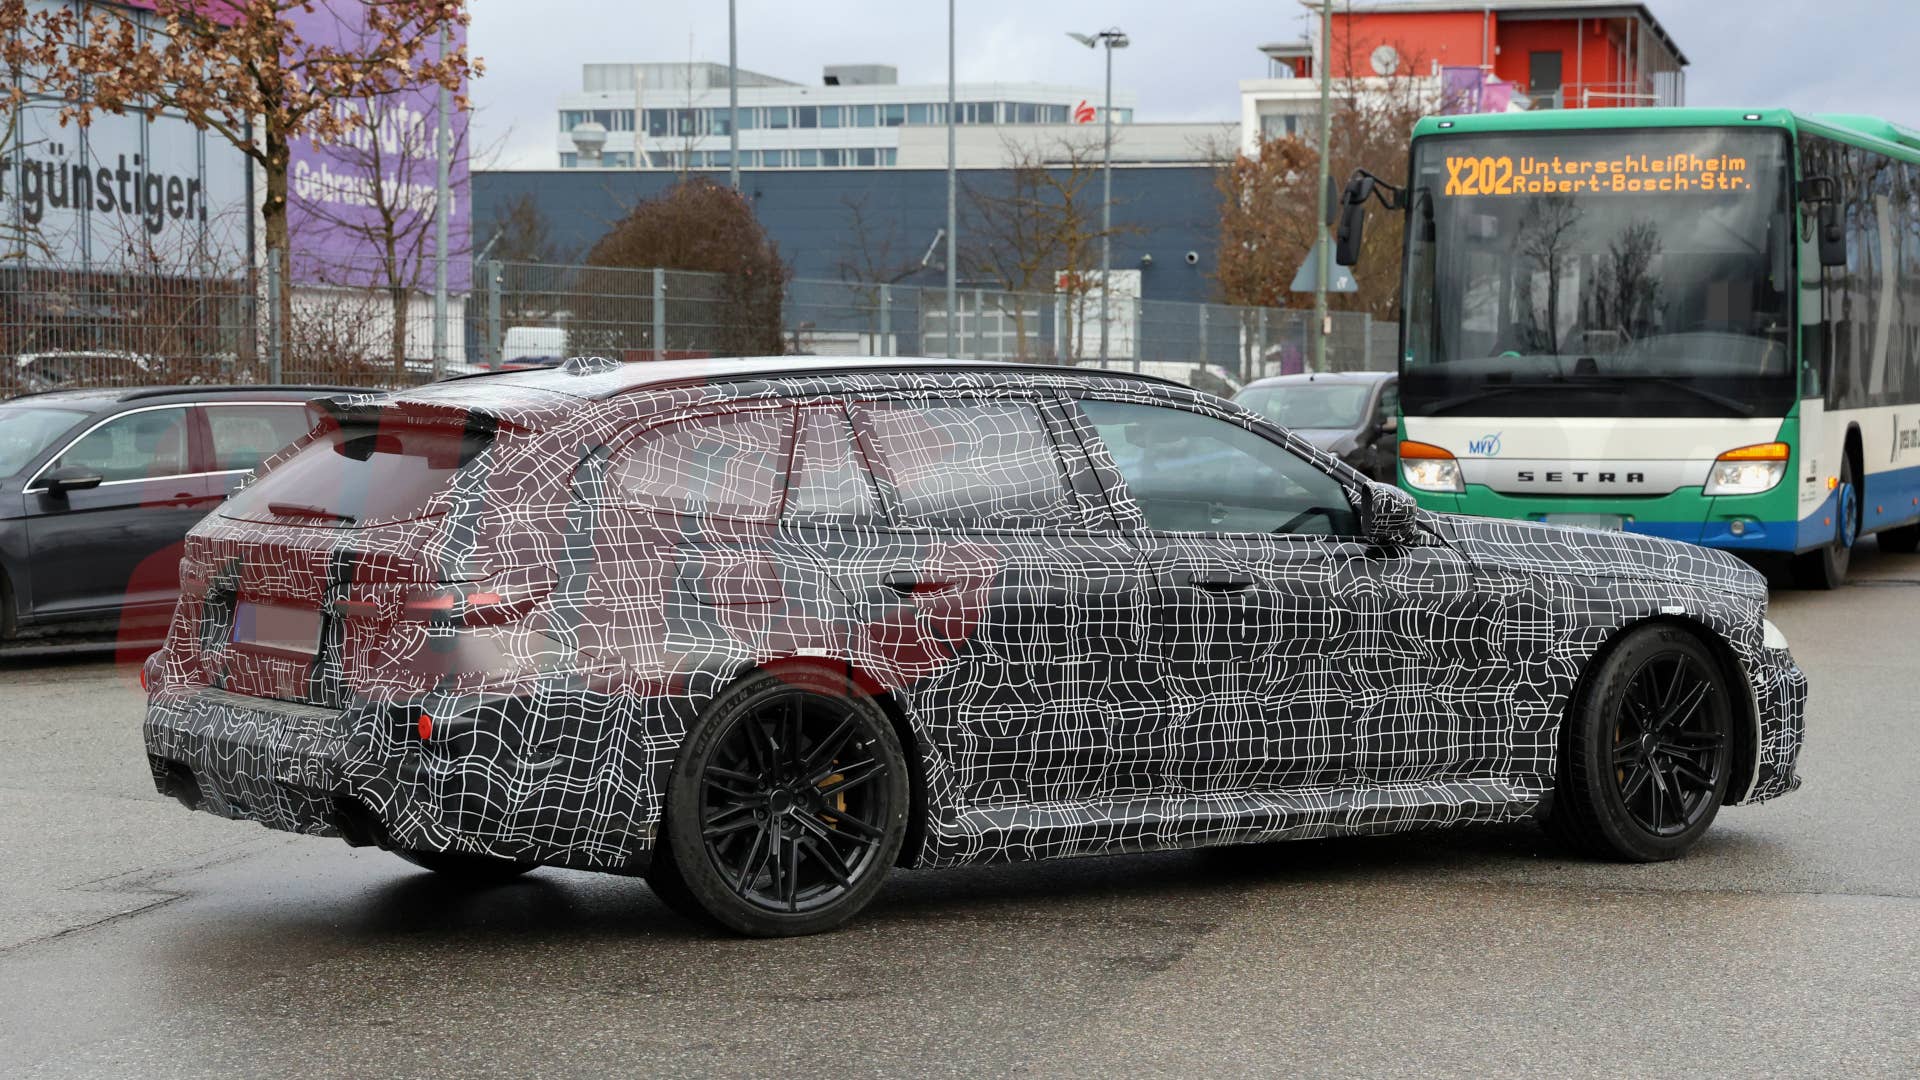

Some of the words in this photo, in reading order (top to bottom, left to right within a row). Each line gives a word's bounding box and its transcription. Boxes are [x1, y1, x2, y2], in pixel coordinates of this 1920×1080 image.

[1445, 156, 1512, 196] X202
[1520, 154, 1746, 175] Unterschleißheim
[1513, 172, 1751, 193] Robert-Bosch-Str.
[22, 142, 207, 234] günstiger.
[1468, 434, 1501, 456] MVV
[1517, 471, 1645, 483] SETRA
